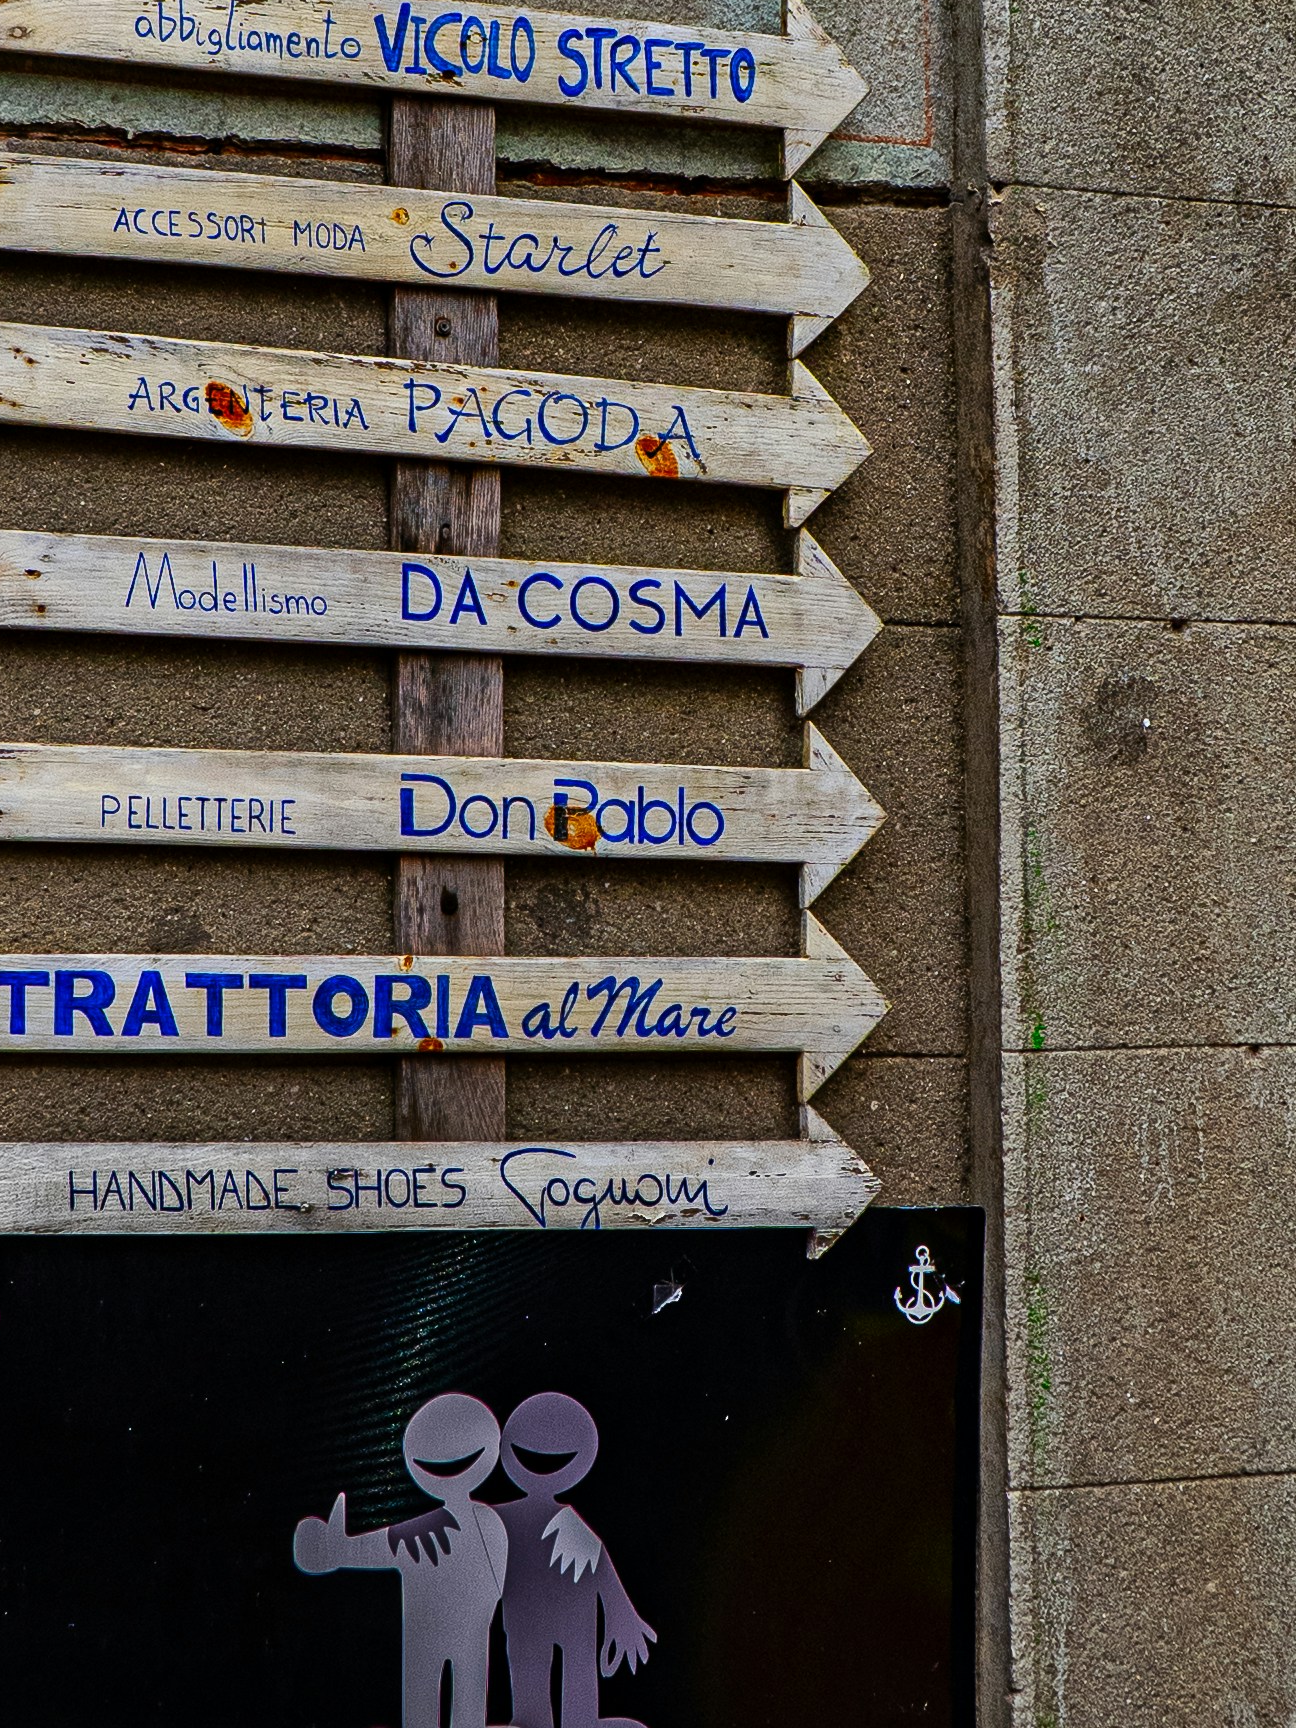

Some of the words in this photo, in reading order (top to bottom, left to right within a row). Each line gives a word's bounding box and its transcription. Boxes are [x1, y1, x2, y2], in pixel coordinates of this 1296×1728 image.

[374, 2, 535, 82] VICOLO
[557, 26, 756, 103] STRETTO
[293, 220, 366, 252] MODA
[410, 200, 666, 279] Starlet
[127, 376, 370, 430] ARGENTERIA
[404, 377, 701, 460] PAGODA
[125, 551, 328, 617] Modellismo
[401, 562, 488, 625] DA
[518, 572, 770, 639] COSMA
[101, 794, 297, 835] PELLETTERIE
[400, 772, 536, 840] Don
[554, 778, 725, 846] Pablo
[521, 981, 578, 1039] al
[587, 975, 738, 1039] Mare
[69, 1167, 301, 1212] HANDMADE
[327, 1167, 467, 1211] SHOES
